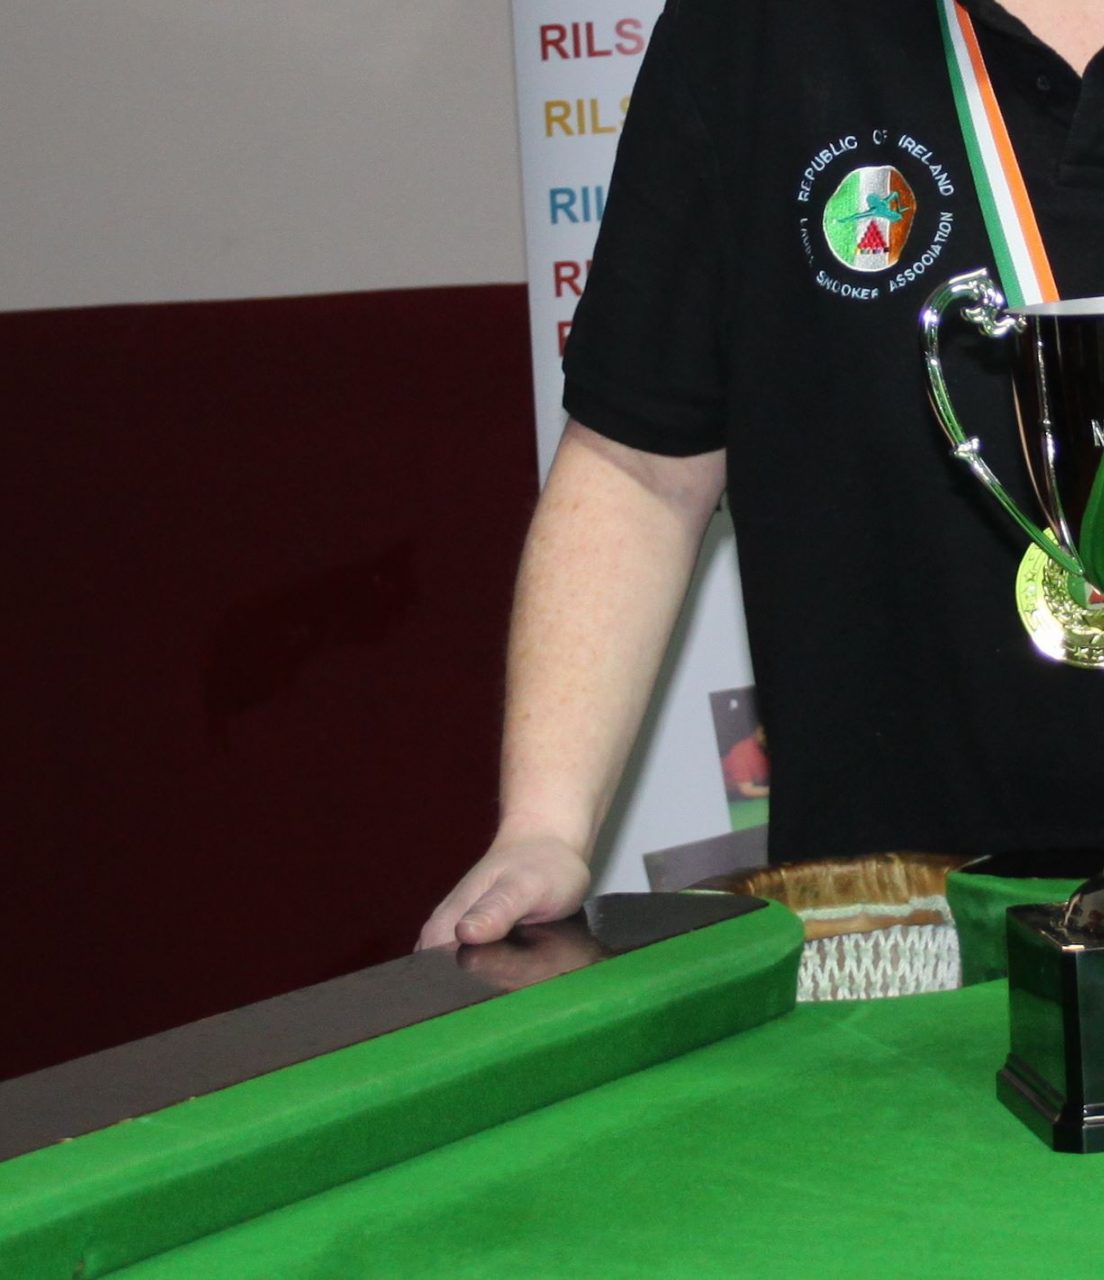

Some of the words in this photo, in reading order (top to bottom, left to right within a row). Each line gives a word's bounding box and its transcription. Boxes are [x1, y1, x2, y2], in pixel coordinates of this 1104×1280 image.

[539, 17, 645, 62] RILS
[798, 135, 858, 202] REPUBLIC
[898, 134, 954, 196] IRELAND
[889, 212, 953, 293] ASSOCIATION
